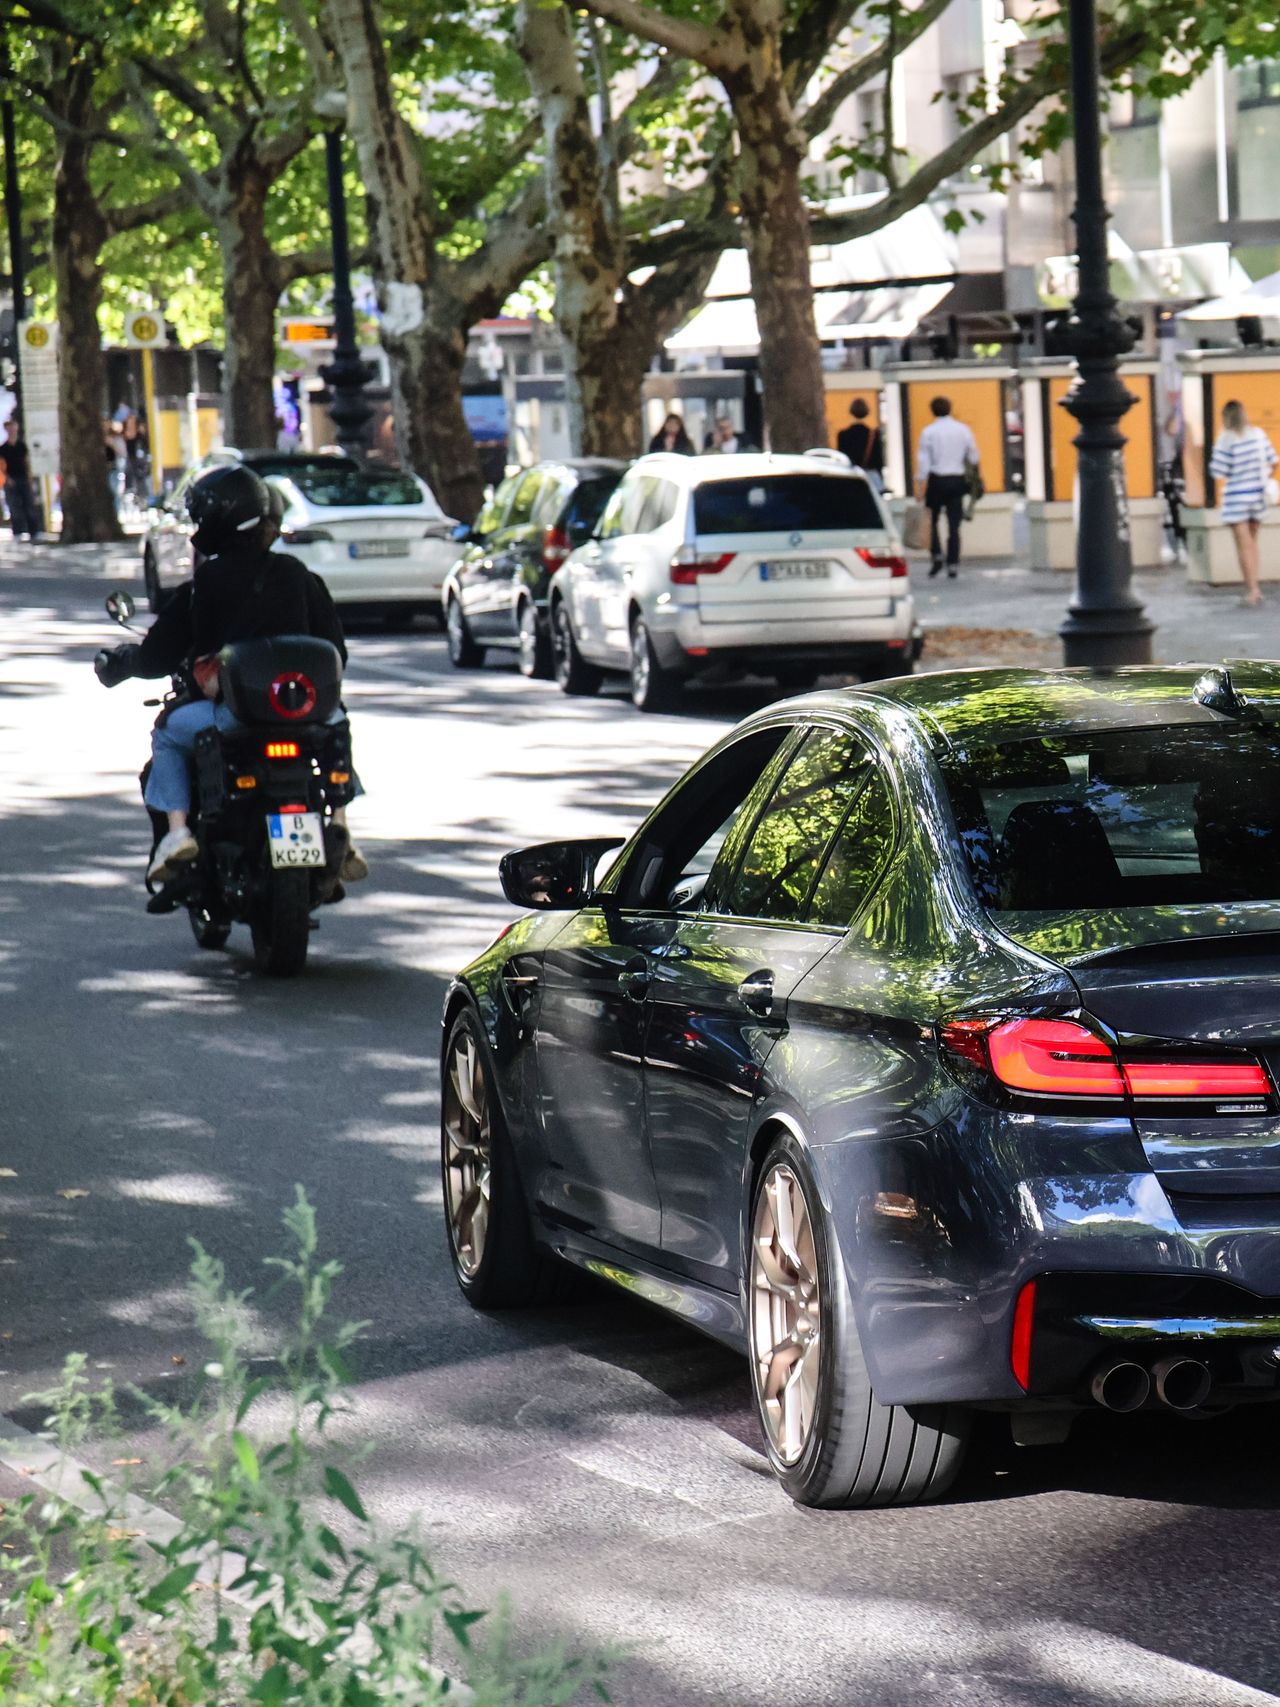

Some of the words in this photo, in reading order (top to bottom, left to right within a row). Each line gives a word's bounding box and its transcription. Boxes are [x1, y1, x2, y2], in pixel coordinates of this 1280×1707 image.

[293, 815, 304, 830] B
[276, 849, 297, 864] KC
[301, 848, 320, 863] 29
